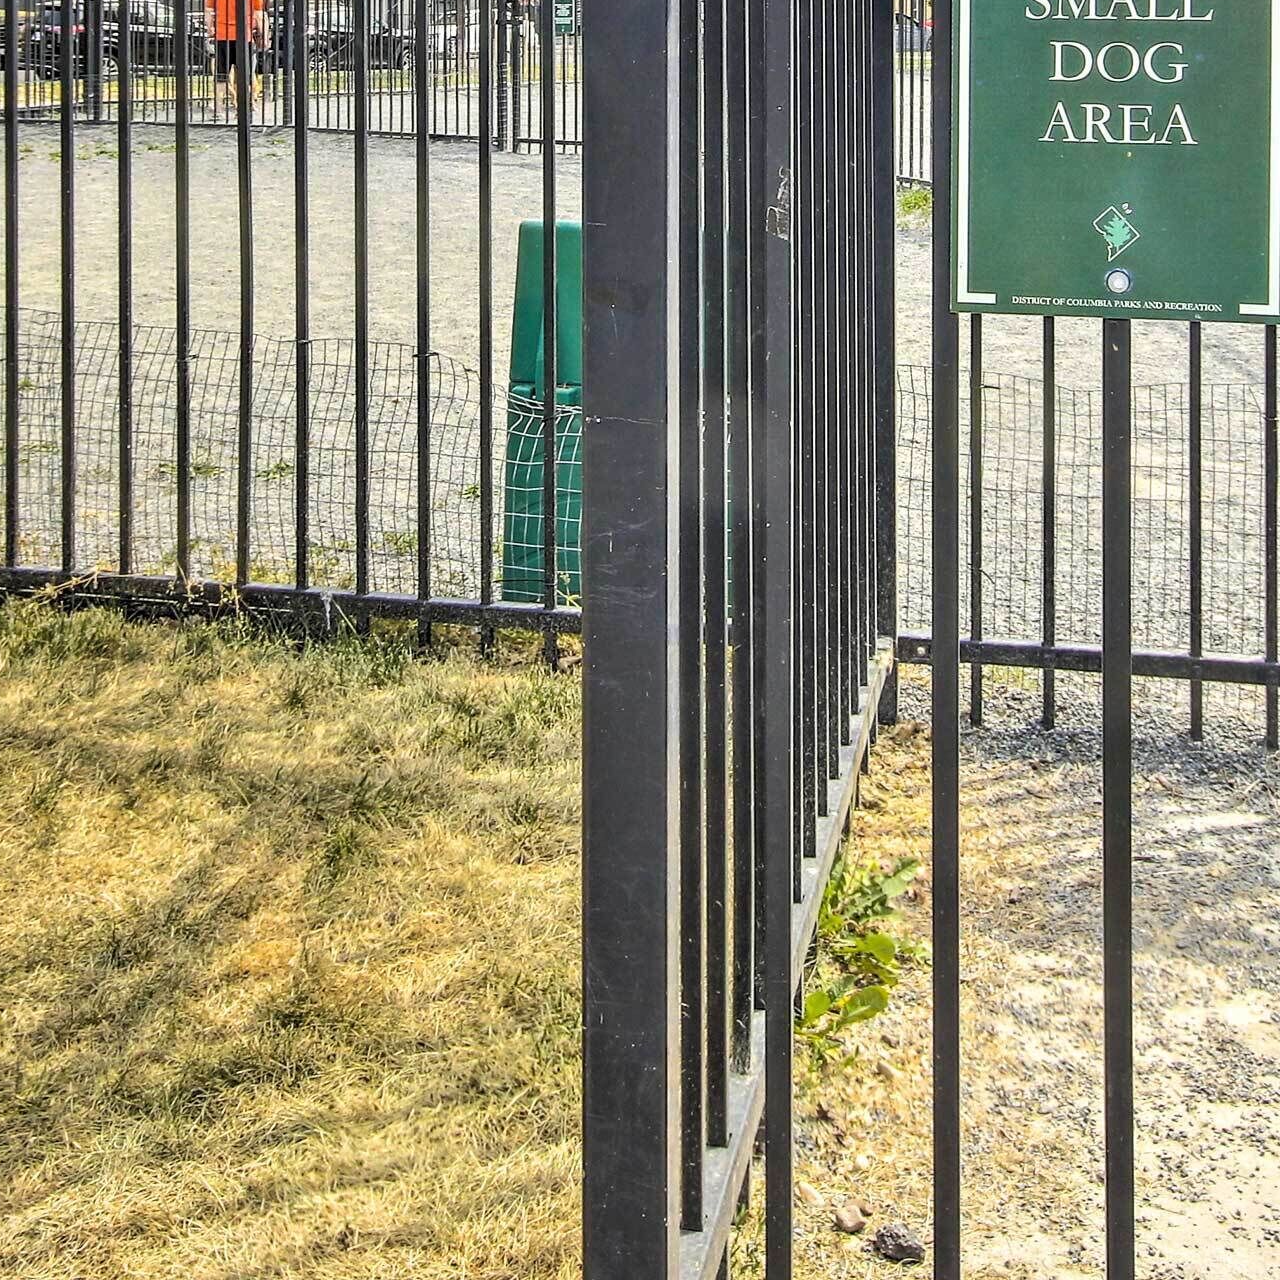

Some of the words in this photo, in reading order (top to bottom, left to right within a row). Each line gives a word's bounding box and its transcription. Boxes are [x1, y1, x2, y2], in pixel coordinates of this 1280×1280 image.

[1048, 40, 1189, 83] DOG
[1038, 100, 1198, 145] AREA
[1012, 295, 1051, 305] DISTRICT
[1052, 297, 1065, 306] OF
[1066, 297, 1113, 308] COLUMBIA
[1114, 300, 1141, 309] PARKS
[1142, 301, 1163, 310] AND
[1164, 302, 1223, 312] RECREATION
